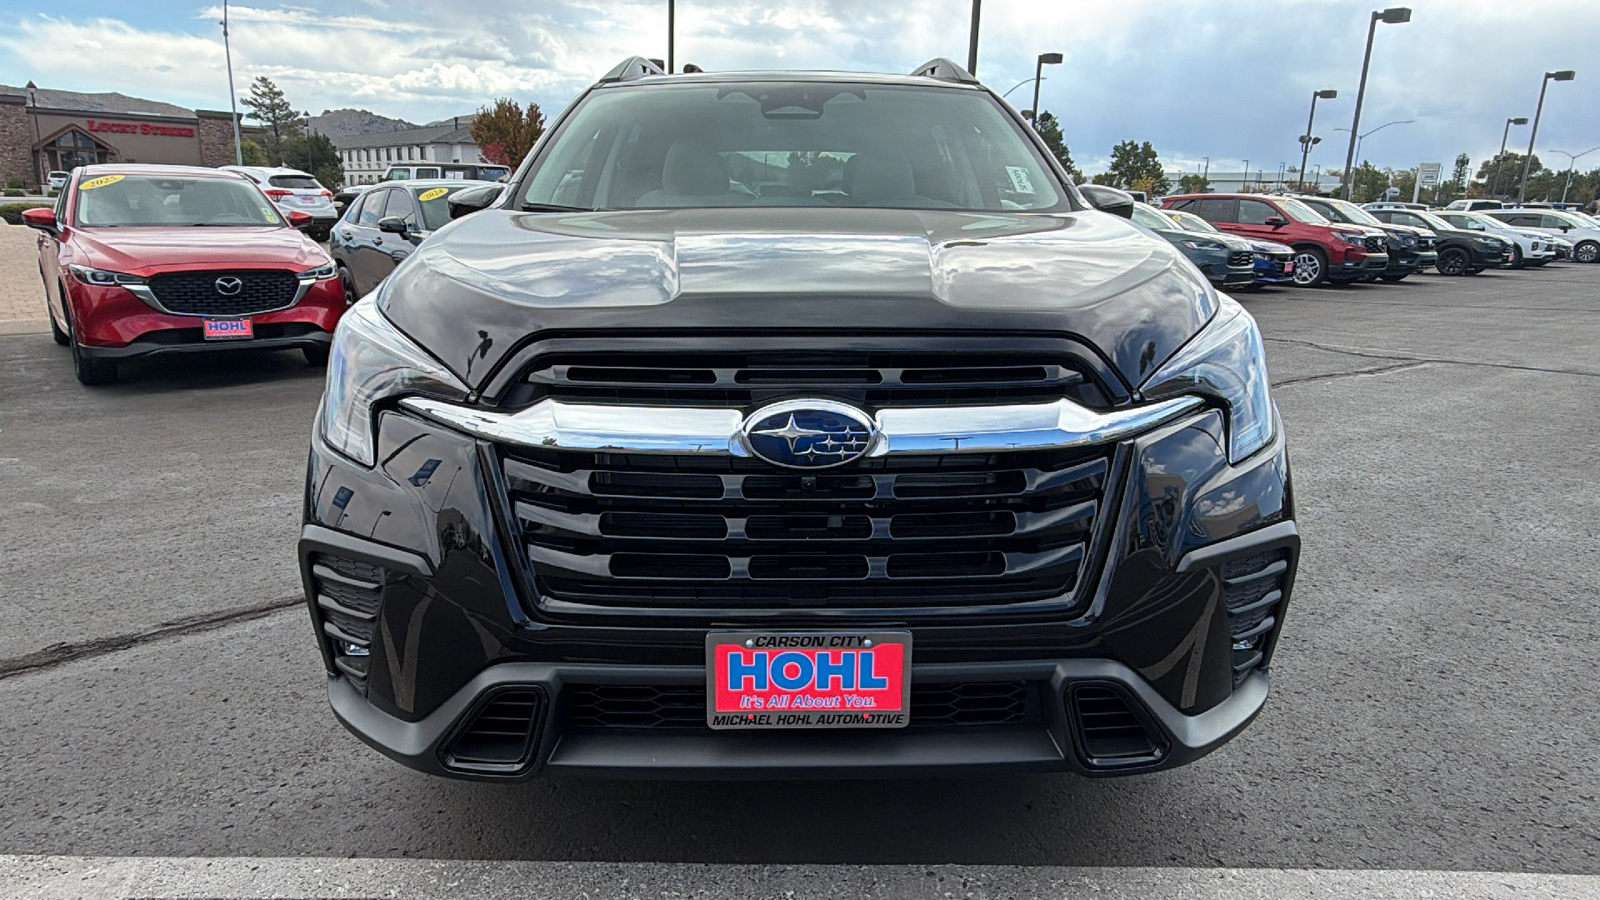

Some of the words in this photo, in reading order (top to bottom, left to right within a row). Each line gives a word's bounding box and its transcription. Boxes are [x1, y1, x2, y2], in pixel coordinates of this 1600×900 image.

[88, 119, 137, 133] LUCKY
[140, 123, 194, 137] STRIKE
[208, 322, 248, 331] HOHL
[755, 635, 825, 647] CARSON
[829, 635, 867, 647] CITY
[728, 651, 888, 690] HOHL
[741, 695, 764, 708] It's
[767, 695, 789, 707] All
[792, 695, 840, 707] About
[845, 695, 876, 707] You.
[712, 714, 772, 726] MICHAEL
[776, 714, 812, 725] HOHL
[816, 713, 904, 725] AUTOMOTIVE
